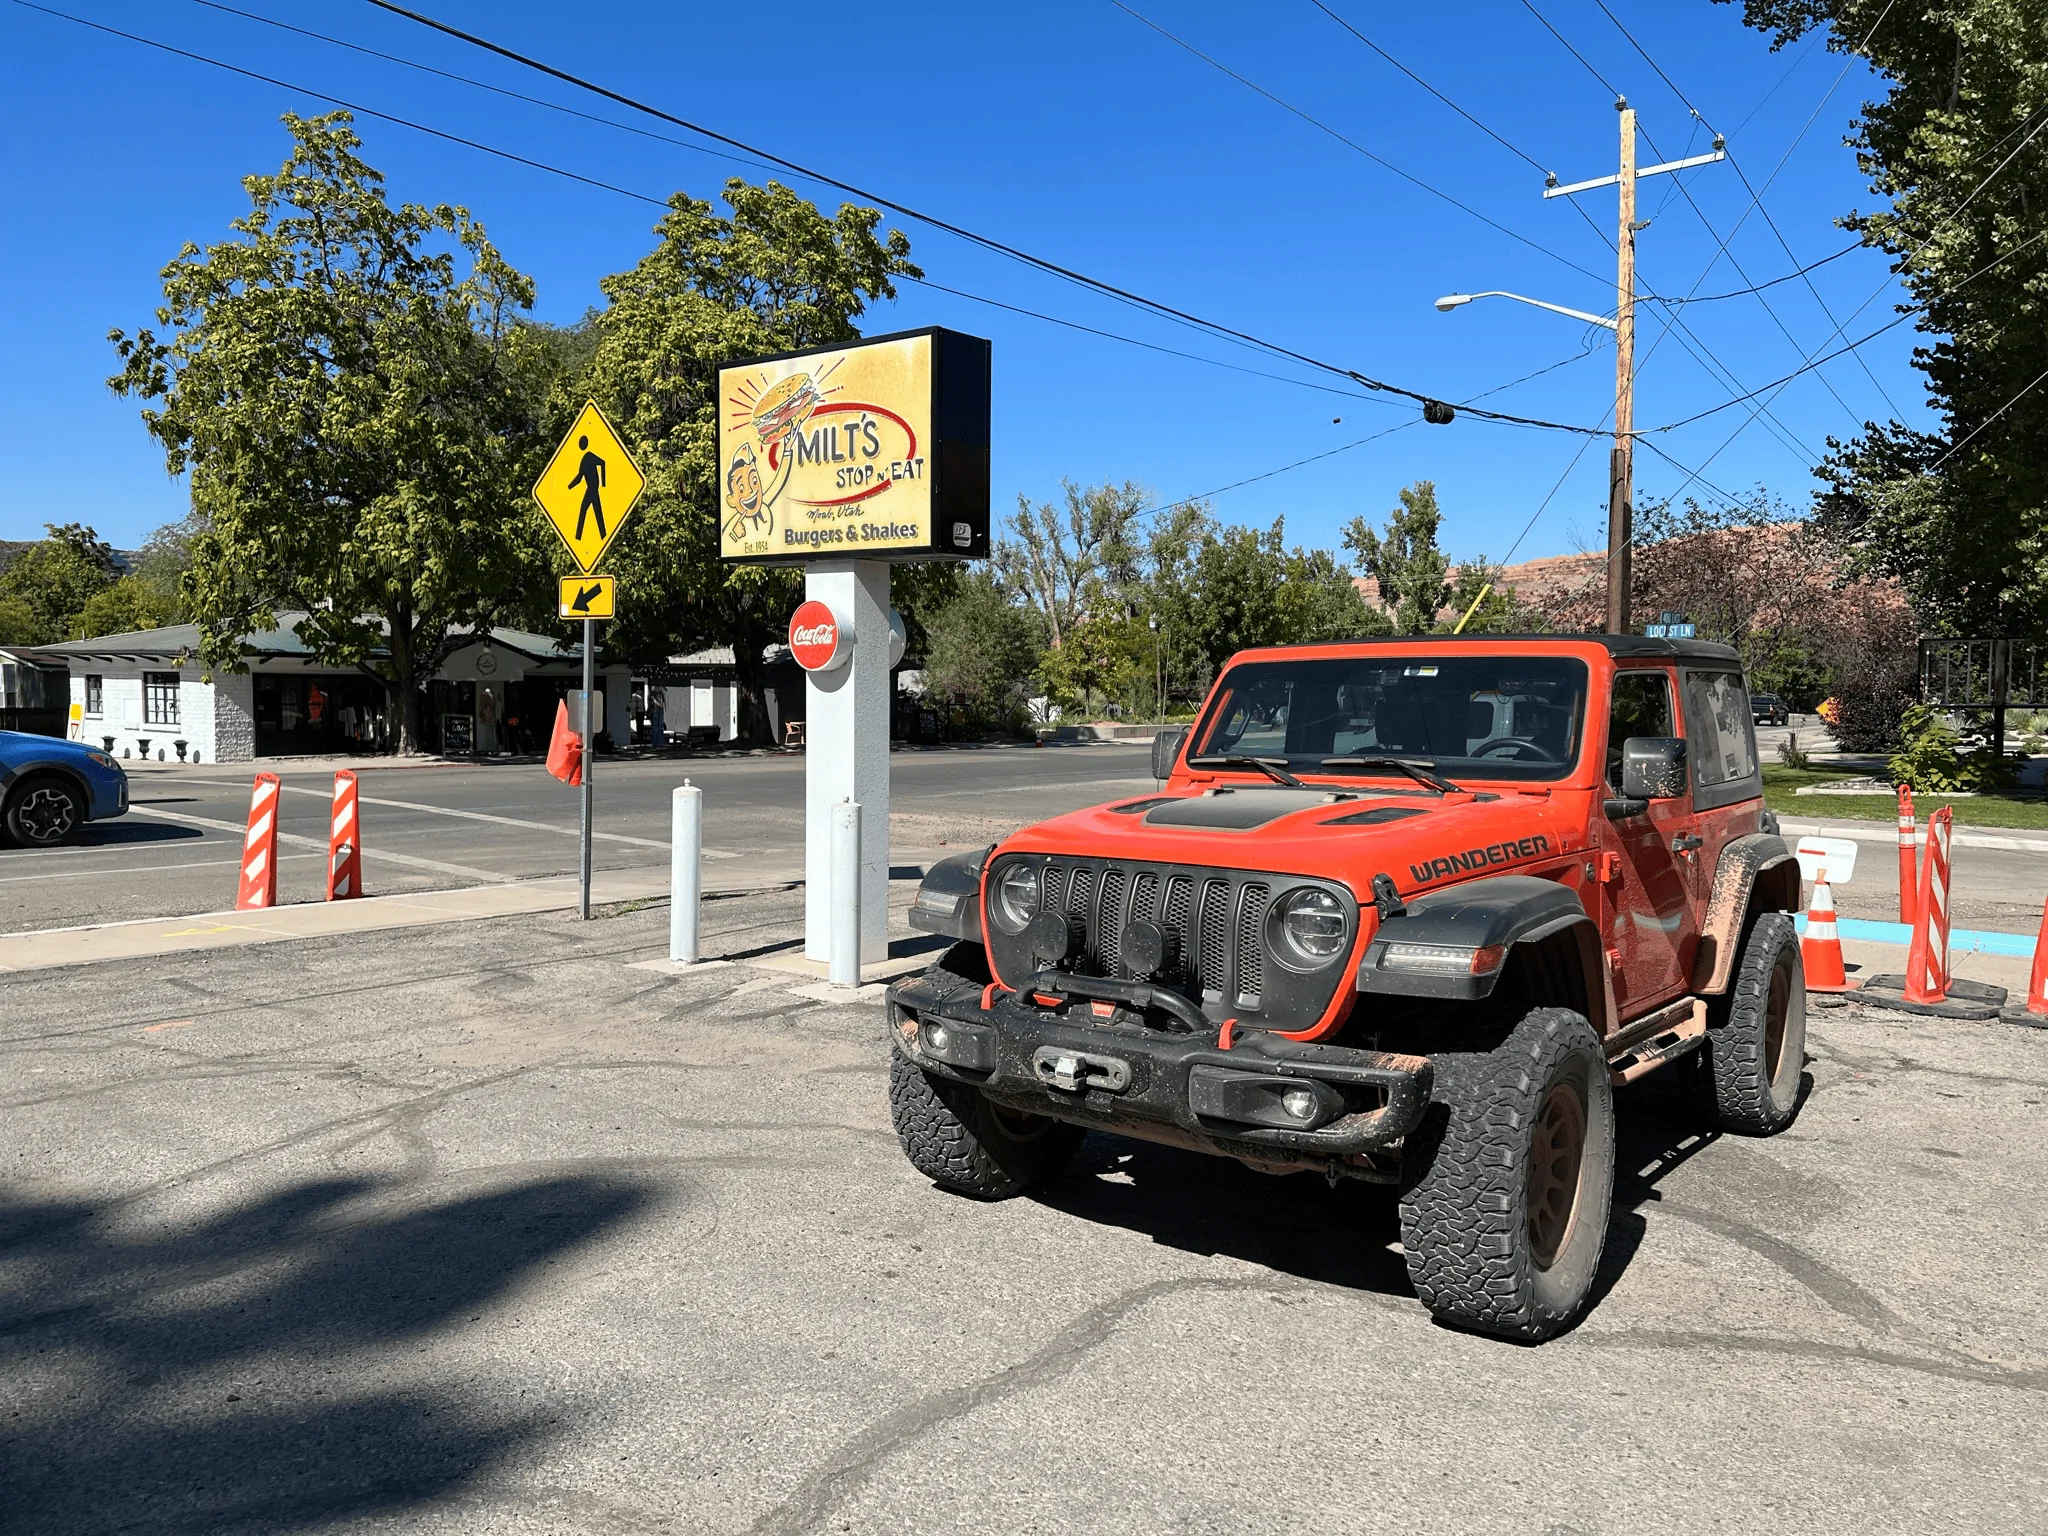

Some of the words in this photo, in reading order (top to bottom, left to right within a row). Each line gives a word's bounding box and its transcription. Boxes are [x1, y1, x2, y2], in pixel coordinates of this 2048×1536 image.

[797, 413, 880, 467] MILT'S
[836, 464, 874, 488] STOP
[891, 458, 924, 480] EAT
[837, 503, 864, 517] Utah
[756, 541, 768, 553] 1954
[785, 528, 843, 548] Burgers
[846, 524, 859, 542] &
[861, 522, 919, 541] Shakes
[793, 624, 835, 646] Coca-Cola
[1680, 625, 1691, 637] LN
[1409, 835, 1549, 883] WANDERER
